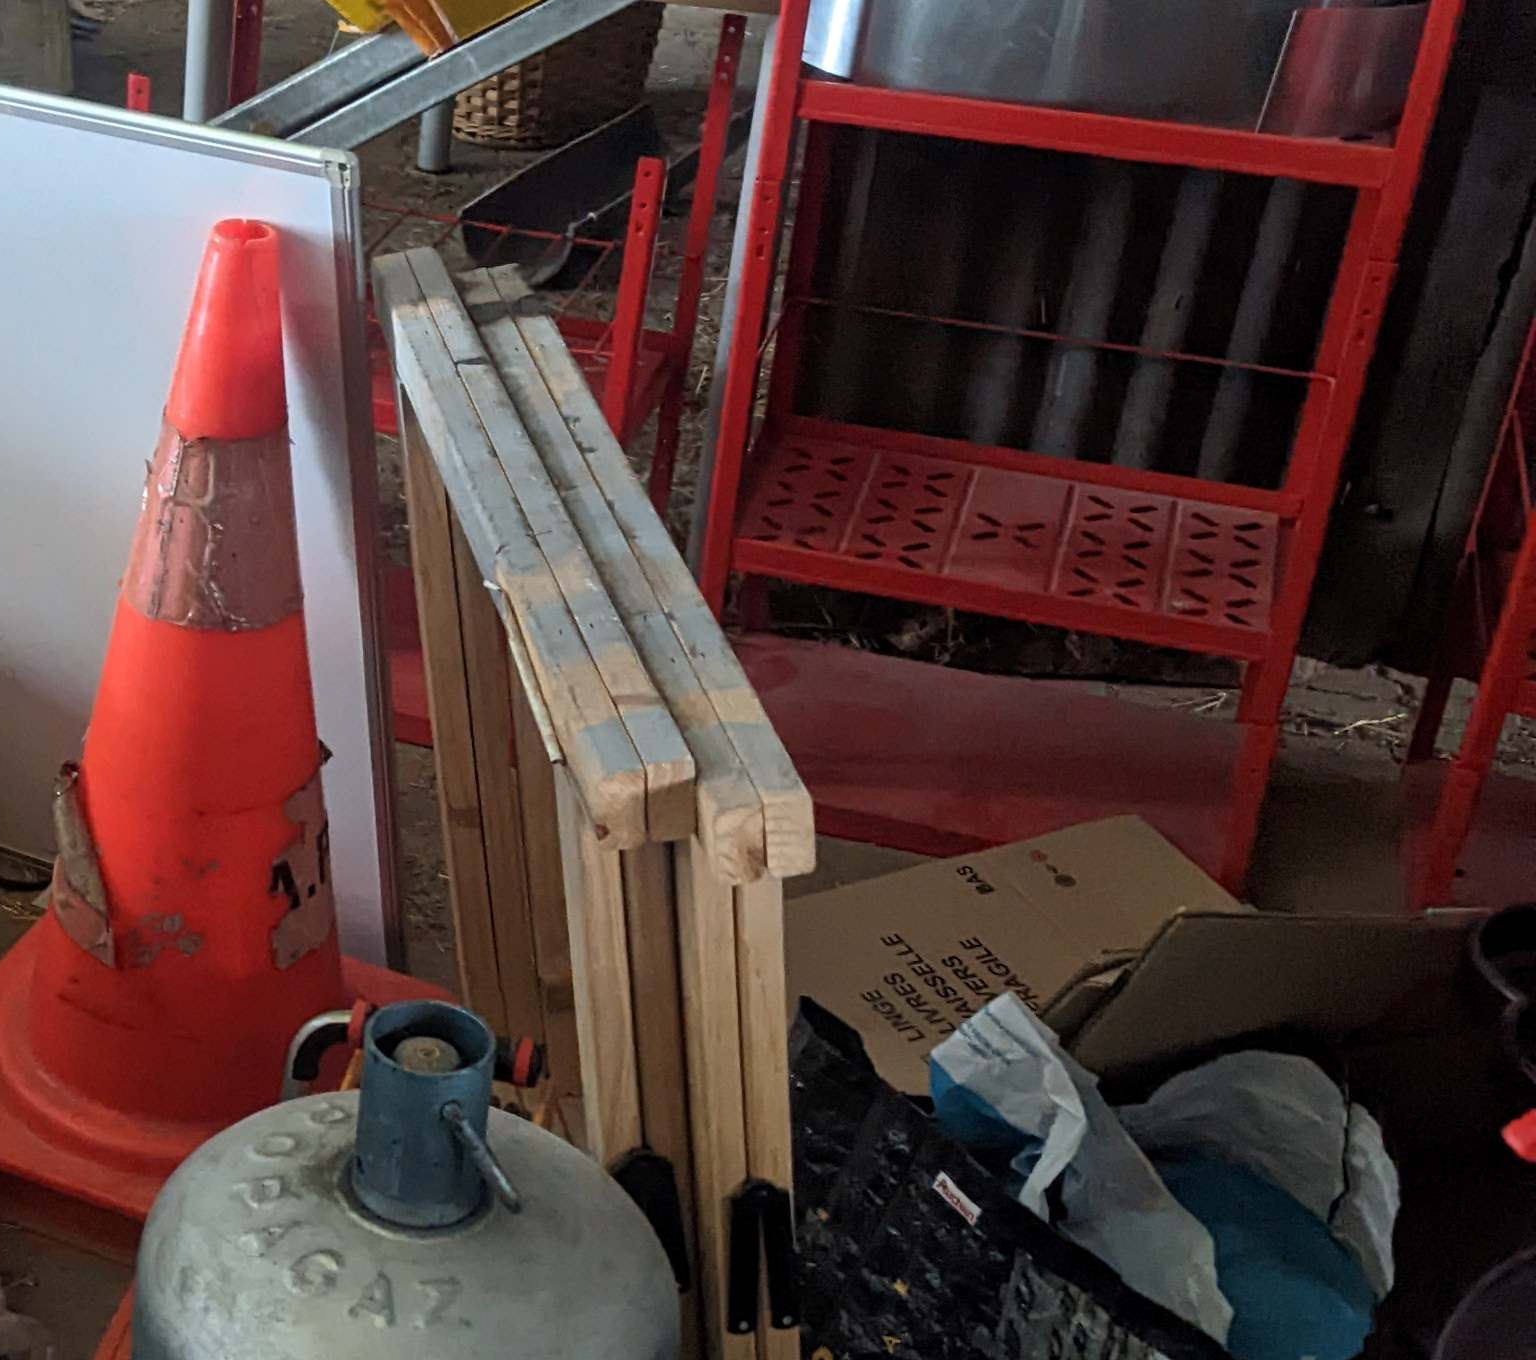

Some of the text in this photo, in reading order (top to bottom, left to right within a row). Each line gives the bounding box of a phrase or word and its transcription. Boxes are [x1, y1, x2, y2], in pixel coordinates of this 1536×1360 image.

[955, 864, 996, 896] BAS
[883, 971, 958, 1035] LIVRES
[941, 955, 998, 1005] VERS
[860, 989, 926, 1042] LINGE
